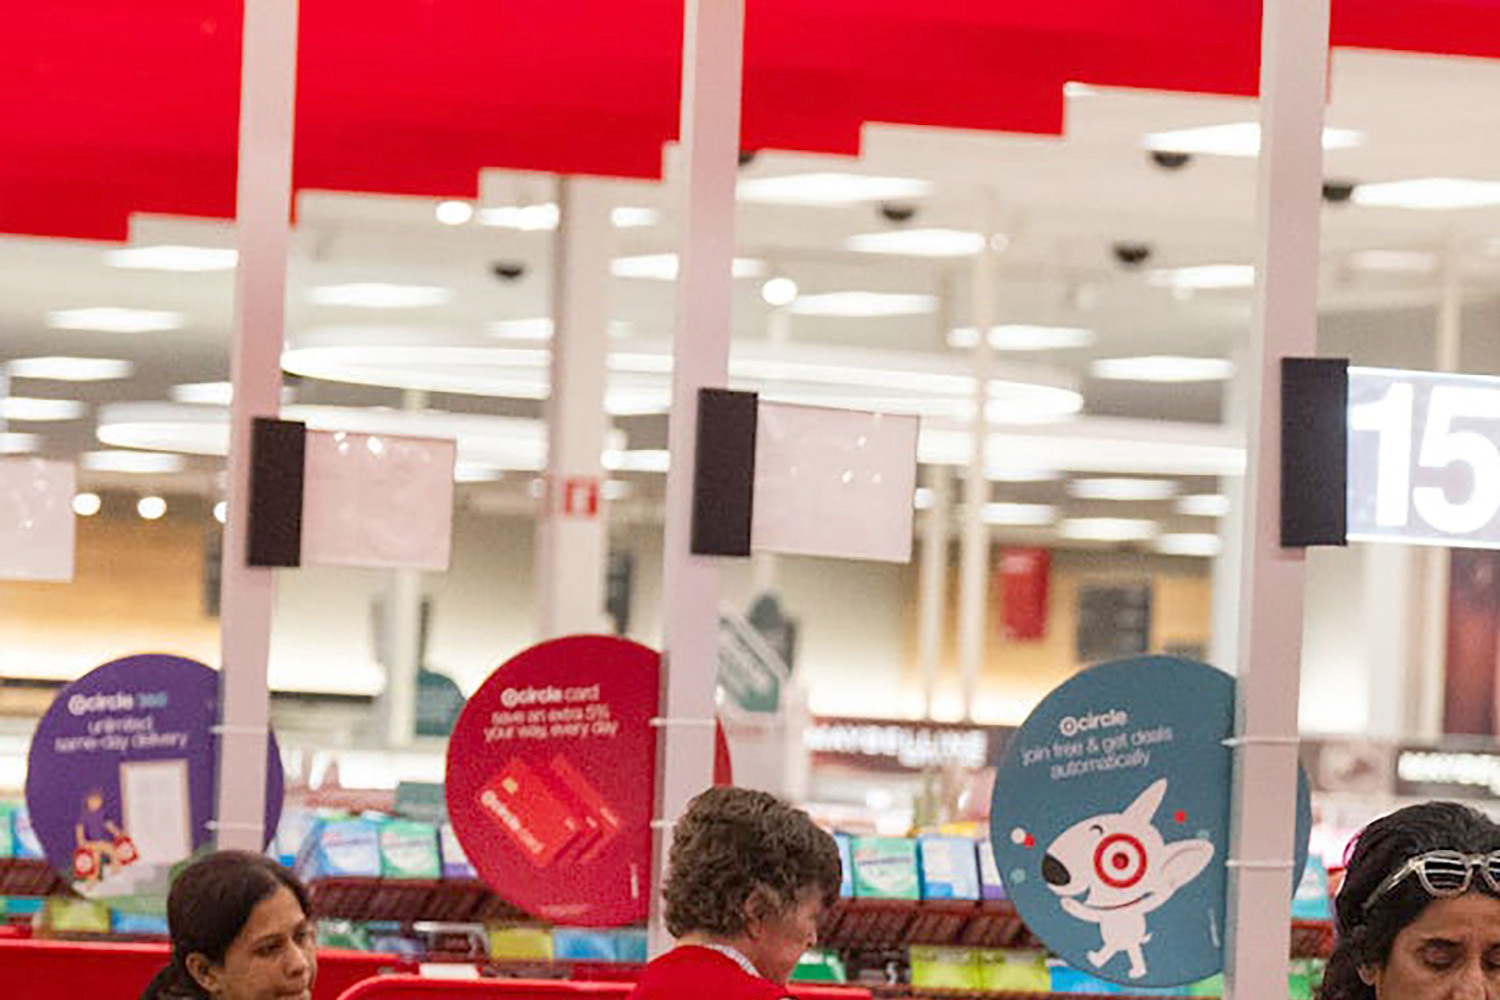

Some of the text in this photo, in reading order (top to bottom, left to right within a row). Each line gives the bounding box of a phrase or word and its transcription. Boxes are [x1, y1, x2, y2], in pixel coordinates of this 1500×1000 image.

[518, 683, 600, 704] circle card
[1078, 709, 1127, 730] circle
[1023, 726, 1173, 767] join free & get deals
[1051, 749, 1149, 780] automatically
